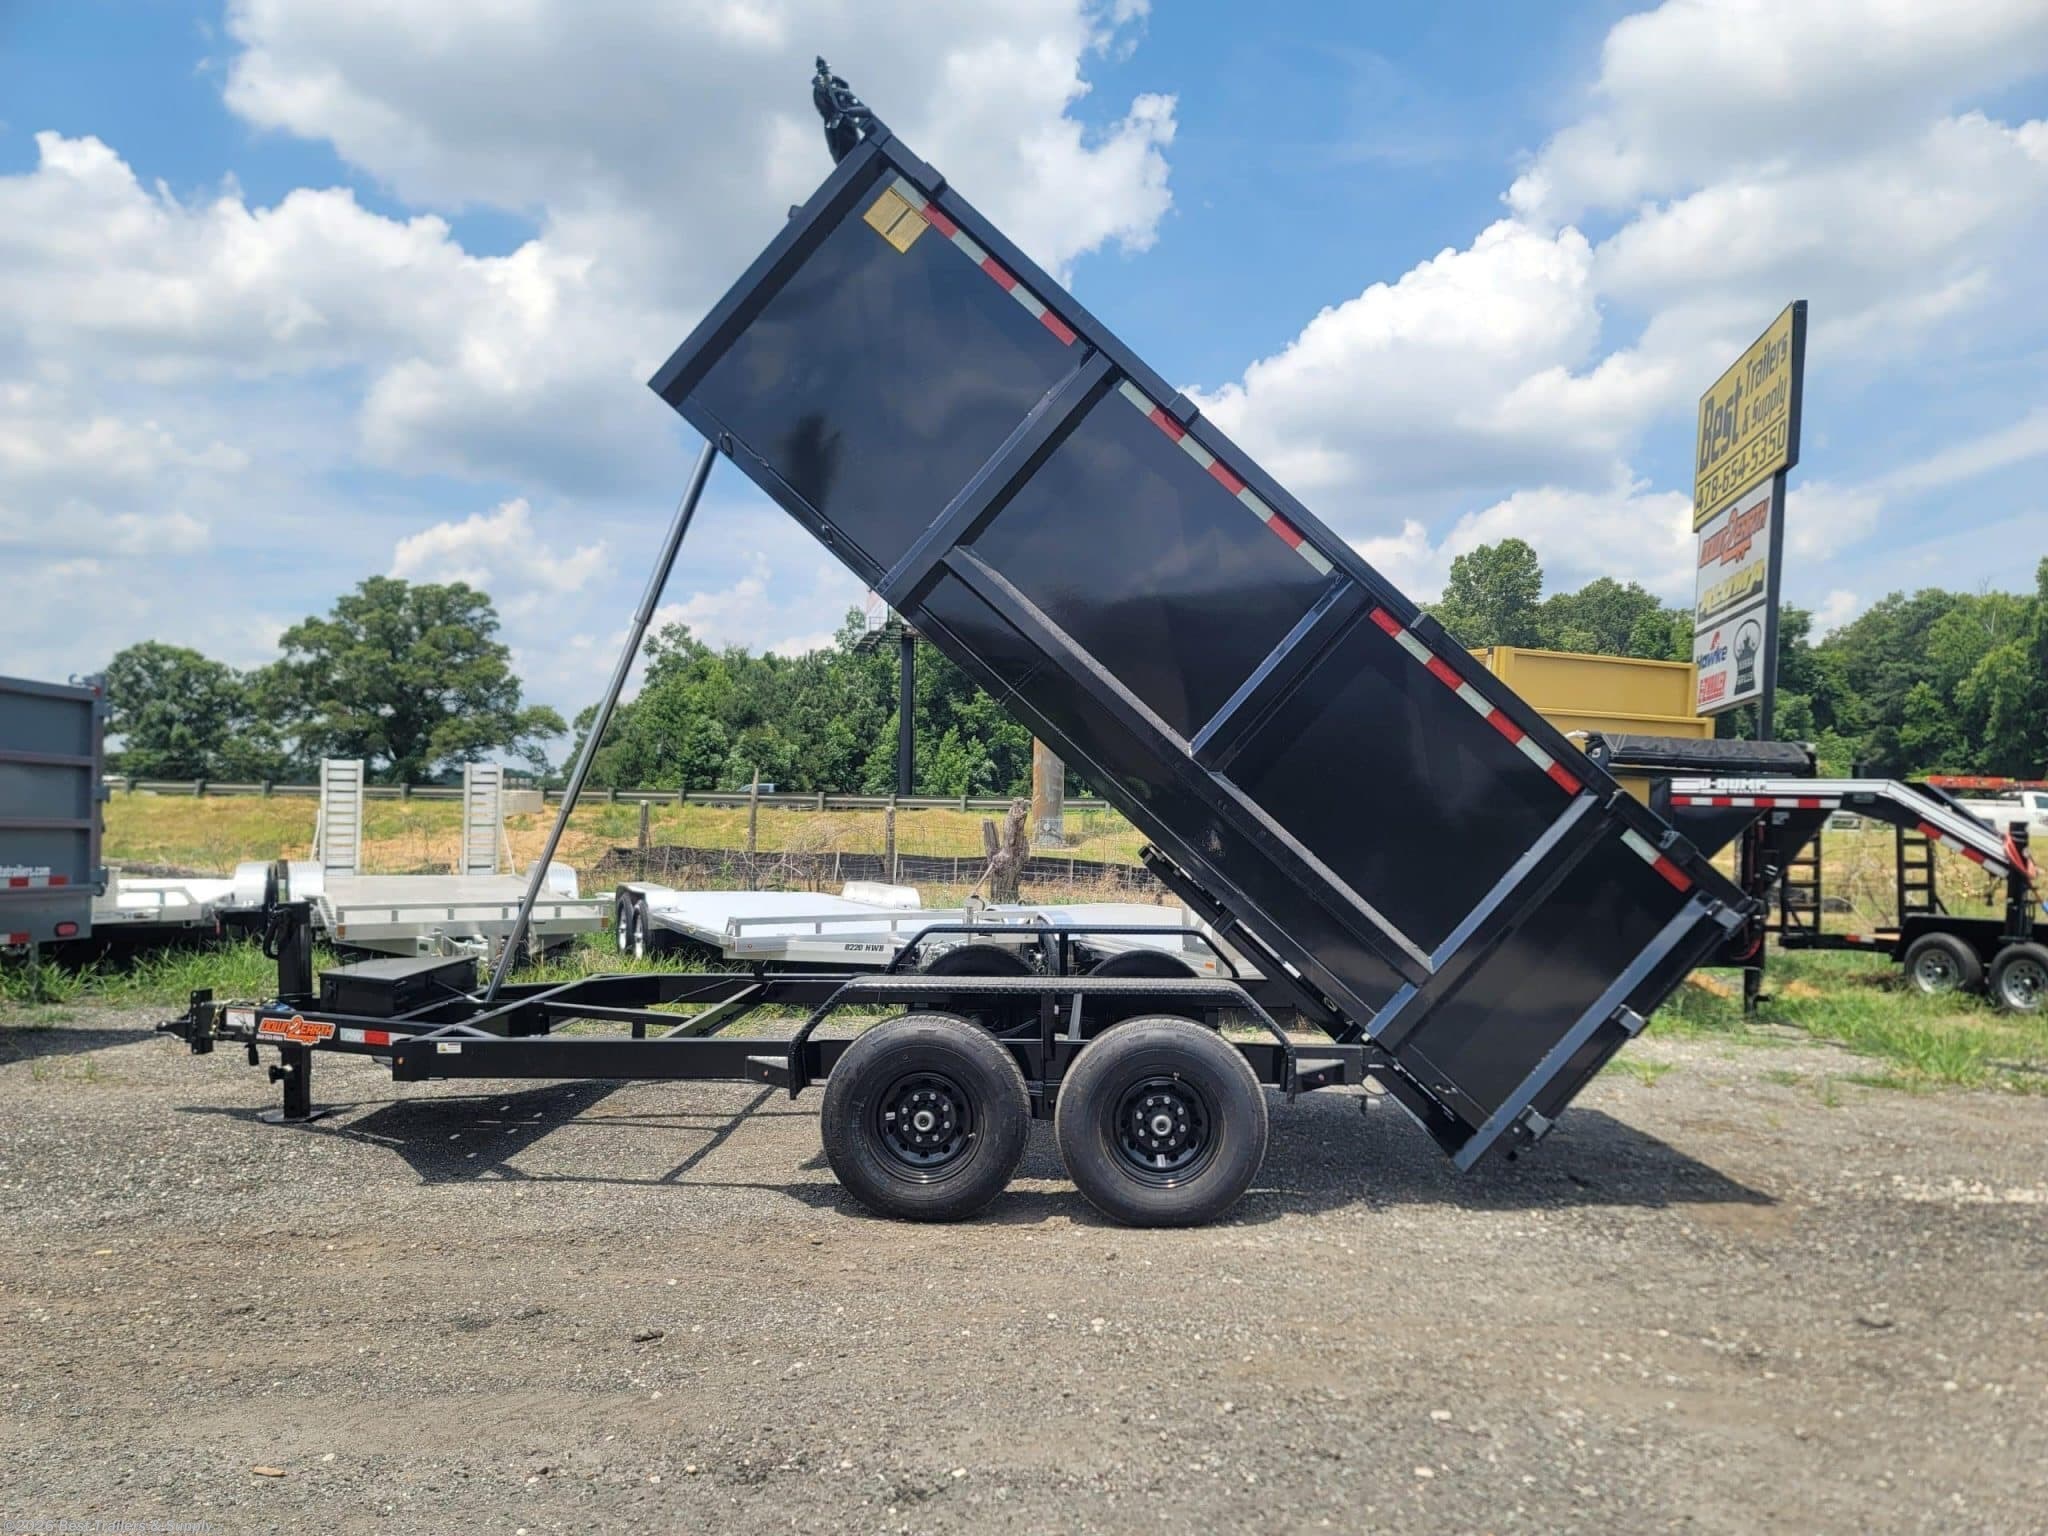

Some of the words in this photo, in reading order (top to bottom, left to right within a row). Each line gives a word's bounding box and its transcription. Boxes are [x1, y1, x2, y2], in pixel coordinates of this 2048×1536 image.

[1701, 376, 1742, 474] Best
[1745, 333, 1788, 397] Trailers
[1751, 376, 1787, 429] Supply
[302, 1023, 333, 1036] EARTH
